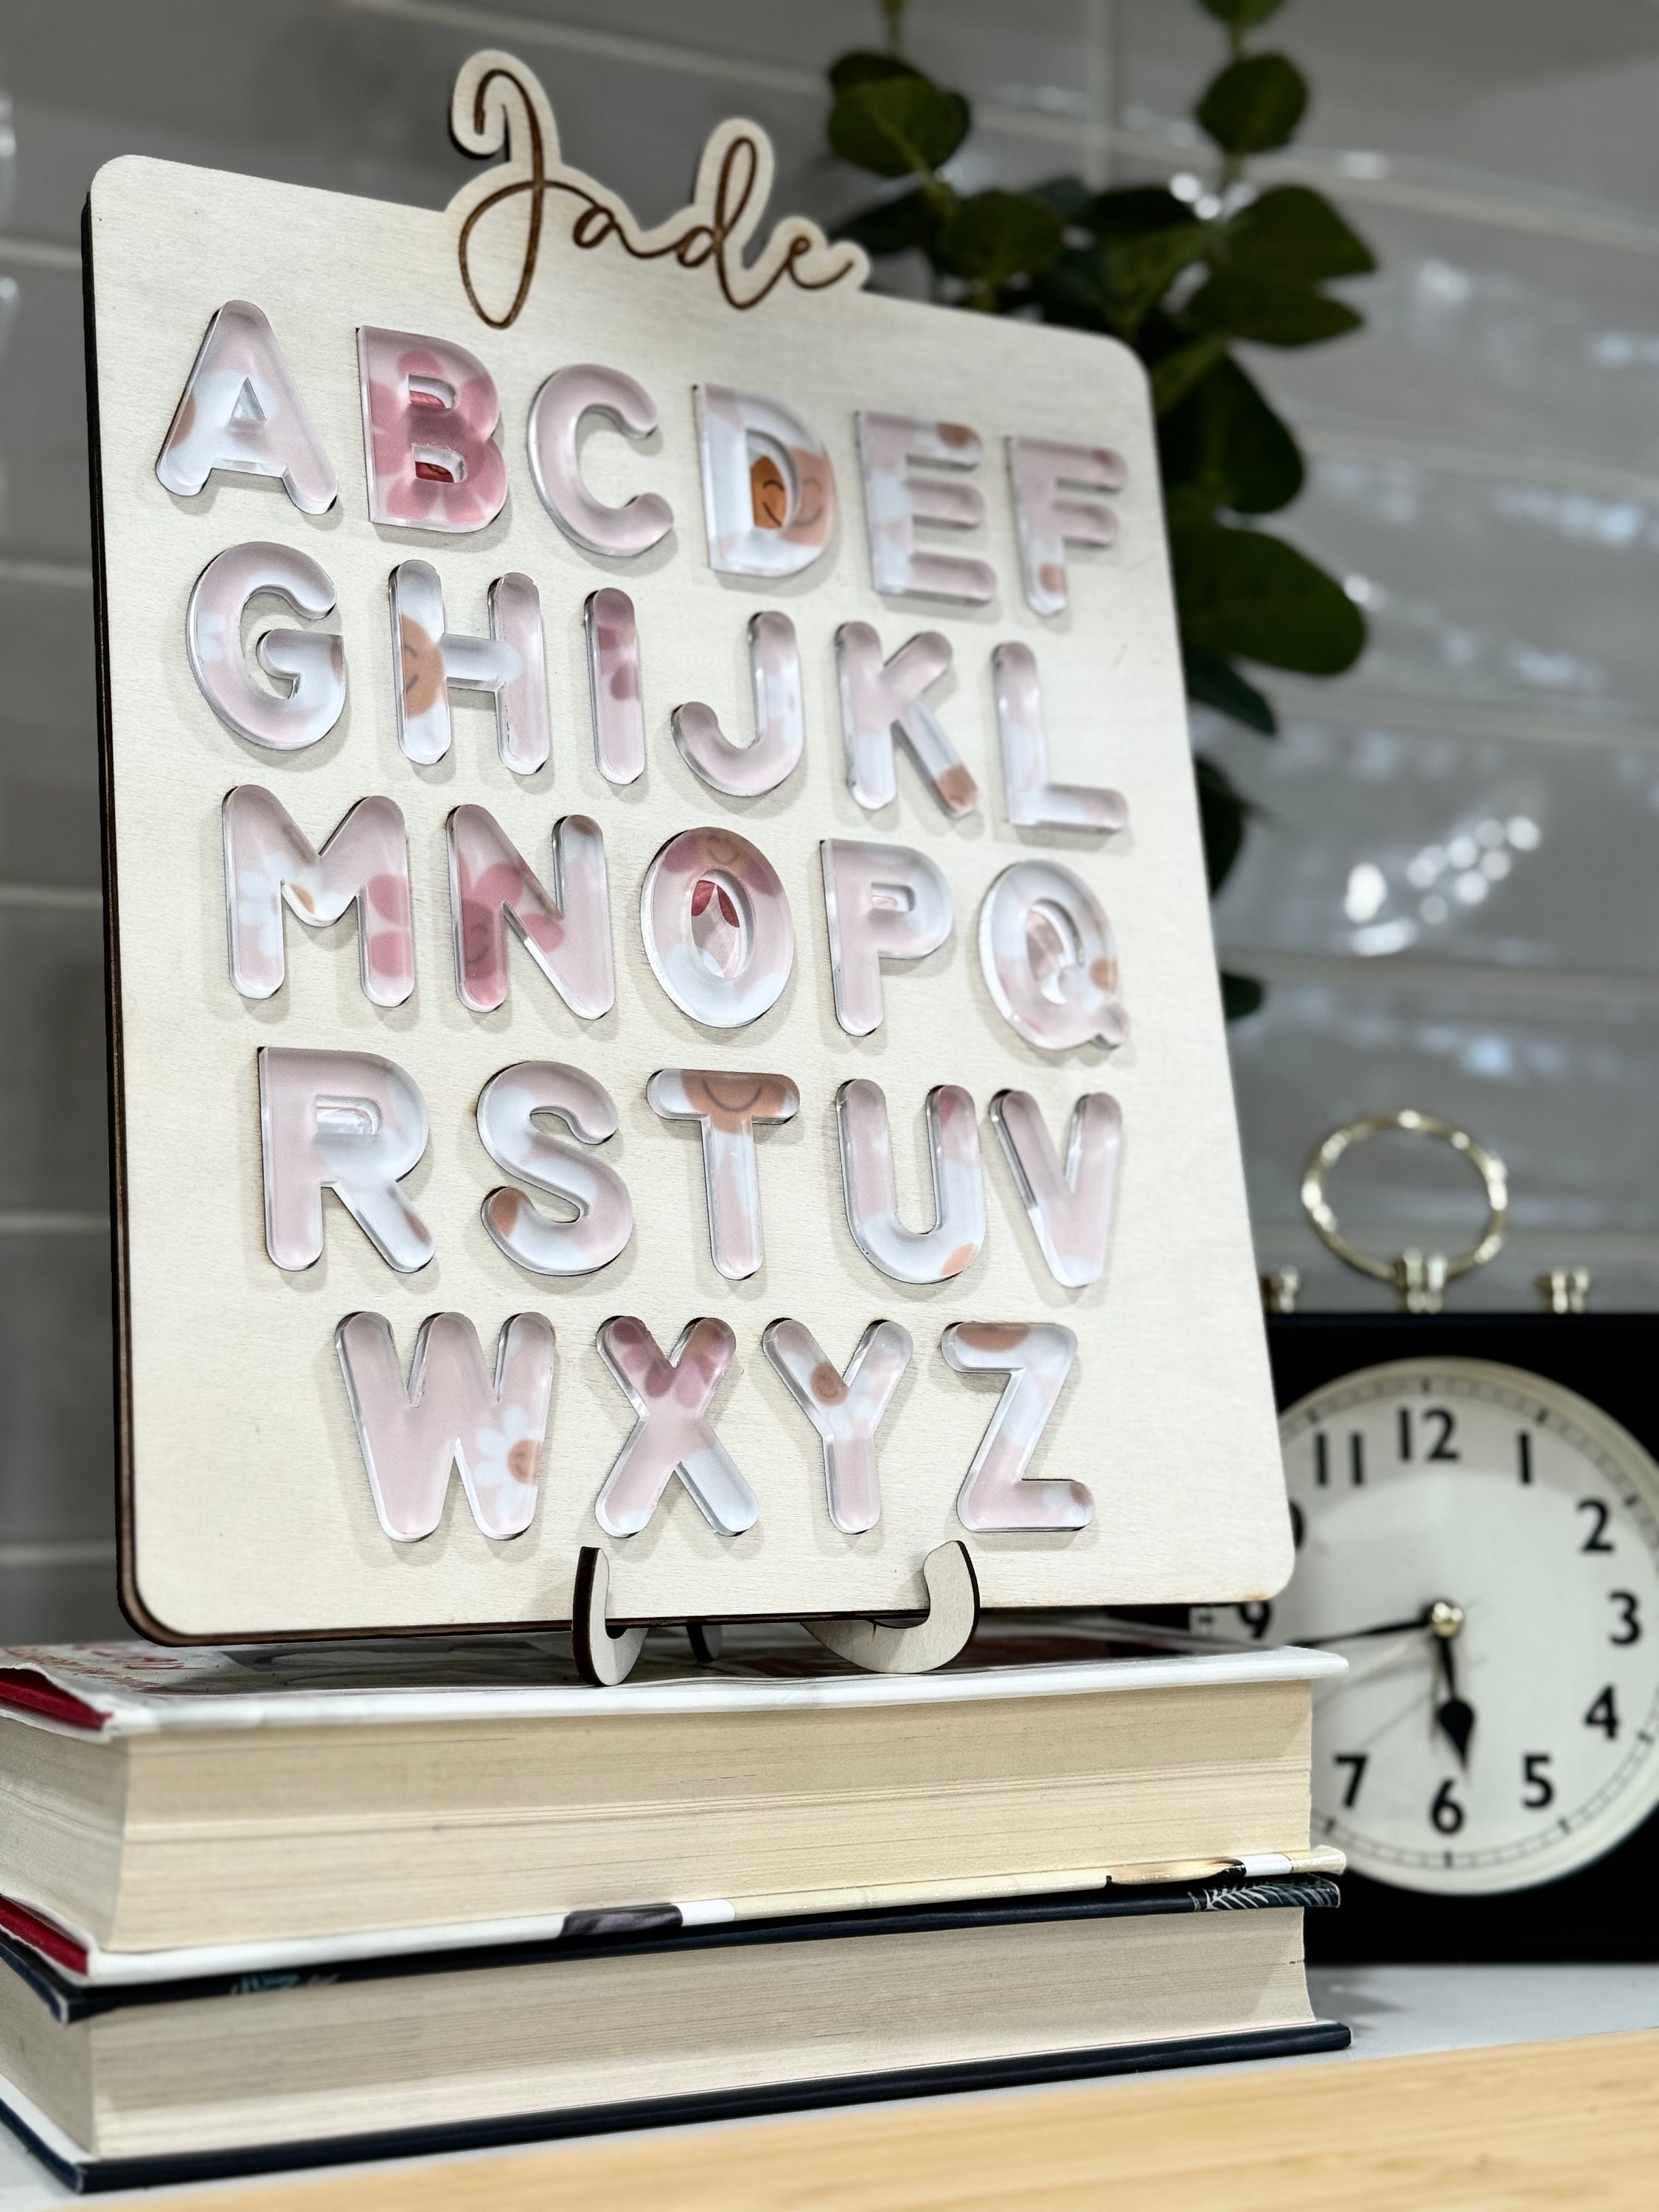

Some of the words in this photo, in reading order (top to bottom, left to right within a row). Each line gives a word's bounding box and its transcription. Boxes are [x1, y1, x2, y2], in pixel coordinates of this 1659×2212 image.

[459, 69, 854, 328] Jade
[154, 299, 337, 515] A
[356, 325, 507, 534] B
[528, 363, 673, 557] C
[692, 383, 838, 578] D
[856, 410, 998, 605] E
[1007, 434, 1127, 616] F
[187, 540, 347, 752] G
[389, 559, 551, 776] H
[585, 588, 645, 785] I
[672, 610, 804, 797] J
[837, 620, 978, 819] K
[990, 640, 1129, 831] L
[222, 784, 414, 1006] M
[446, 804, 615, 1020] N
[641, 826, 795, 1029] O
[821, 838, 953, 1037] P
[978, 859, 1130, 1051] Q
[258, 1046, 434, 1273] R
[474, 1060, 633, 1276] S
[646, 1069, 799, 1280] T
[836, 1079, 987, 1284] U
[990, 1090, 1123, 1287] V
[335, 1311, 555, 1542] W
[595, 1315, 759, 1537] X
[762, 1318, 913, 1534] Y
[942, 1322, 1096, 1531] Z
[1399, 1408, 1460, 1461] 12
[1315, 1431, 1364, 1486] 11
[1520, 1431, 1534, 1485] 1
[1576, 1499, 1614, 1551] 2
[1609, 1591, 1642, 1646] 3
[1584, 1686, 1619, 1739] 4
[1335, 1755, 1370, 1809] 7
[1430, 1780, 1465, 1834] 6
[1522, 1755, 1554, 1809] 5
